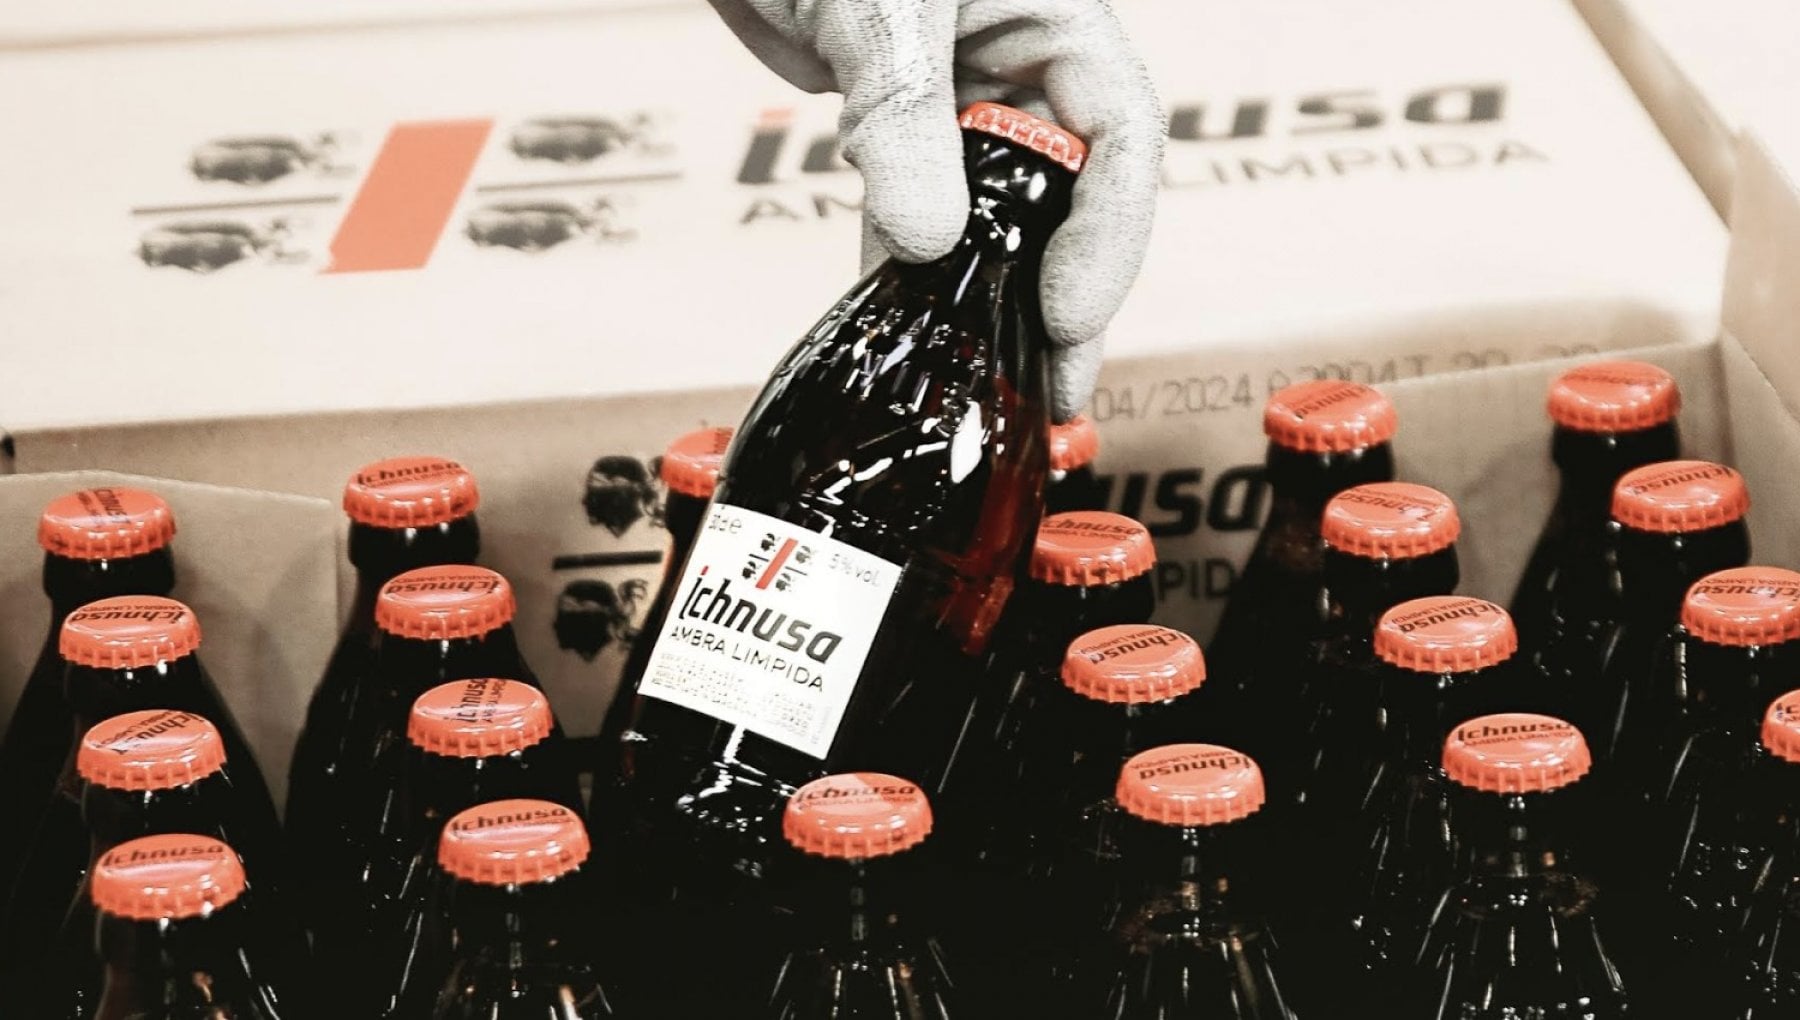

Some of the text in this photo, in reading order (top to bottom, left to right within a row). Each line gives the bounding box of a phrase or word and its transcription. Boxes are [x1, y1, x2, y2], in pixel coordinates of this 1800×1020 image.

[384, 580, 501, 595] ichnusa
[69, 611, 187, 625] ichnusa
[679, 565, 843, 665] ichnusa
[1399, 603, 1503, 633] ichnusa
[670, 625, 726, 656] AMBRA
[732, 643, 823, 692] LIMPIDA
[1089, 631, 1191, 665] ichnusa
[1139, 756, 1251, 780] ichnusa
[795, 786, 916, 803] ichnusa
[451, 807, 569, 832] ichnusa
[102, 845, 225, 867] ichnusa
